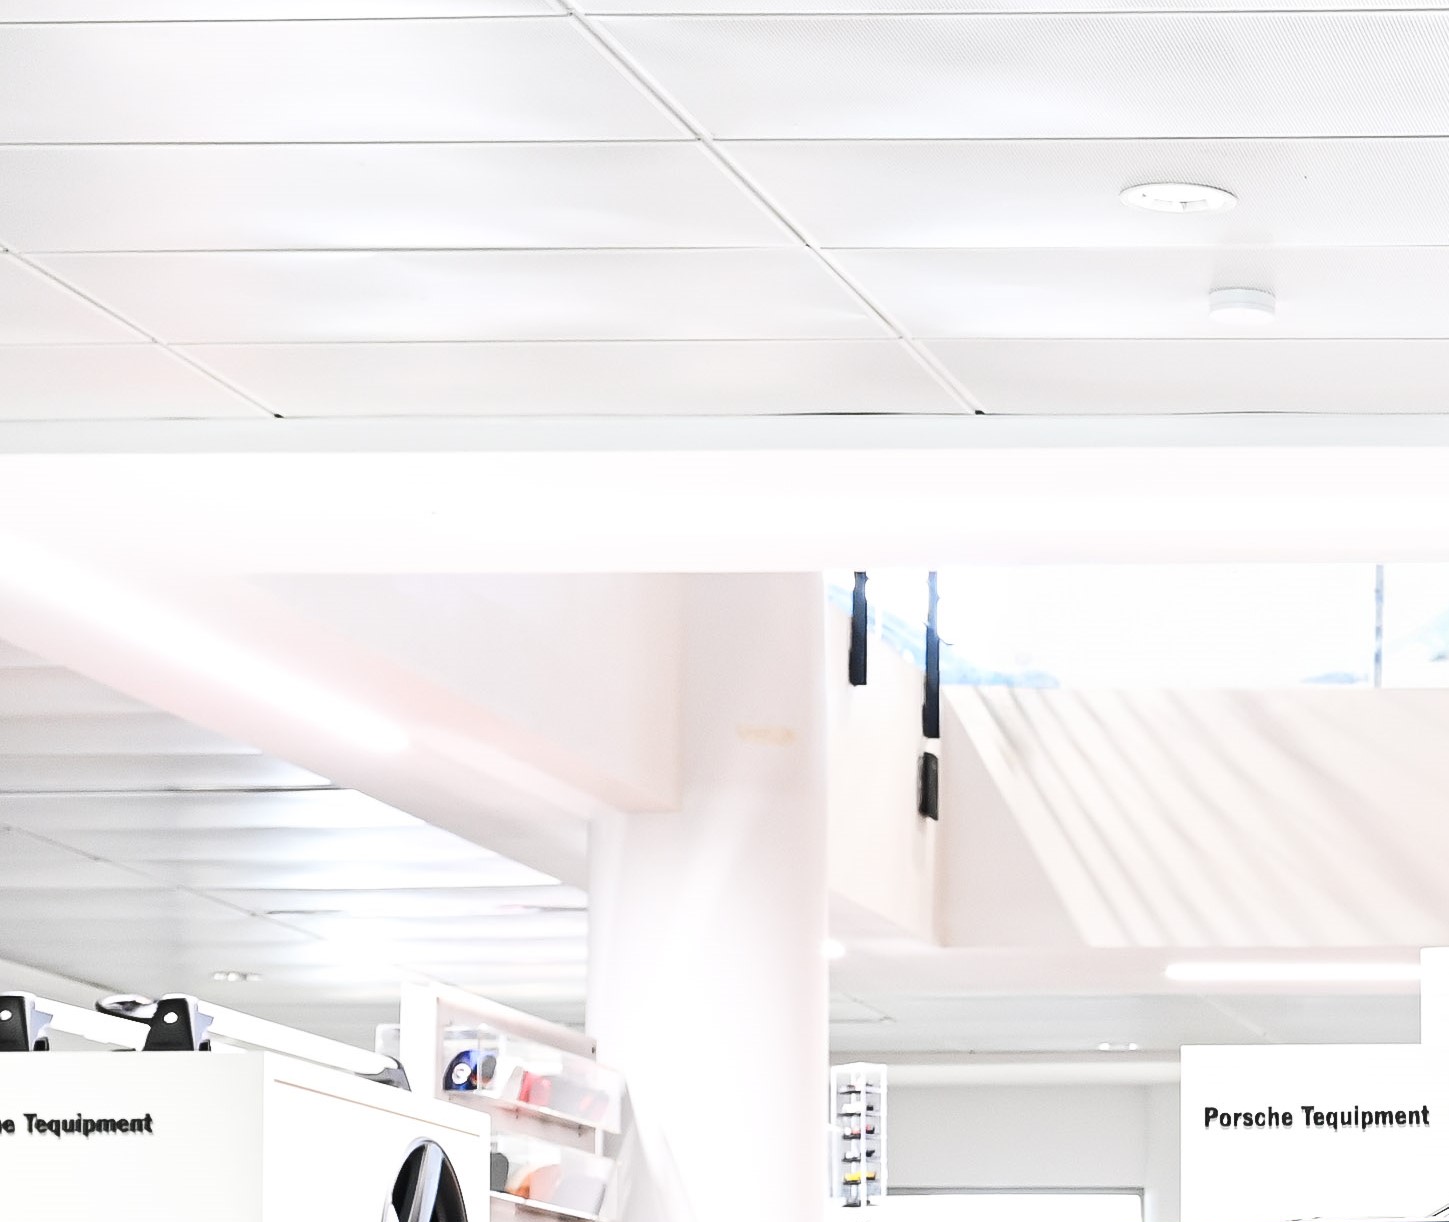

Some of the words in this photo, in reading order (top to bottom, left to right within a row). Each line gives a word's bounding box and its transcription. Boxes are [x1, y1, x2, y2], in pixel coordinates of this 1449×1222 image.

[23, 1112, 153, 1138] Tequipment
[1204, 1106, 1293, 1128] Porsche
[1301, 1105, 1430, 1130] Tequipment
